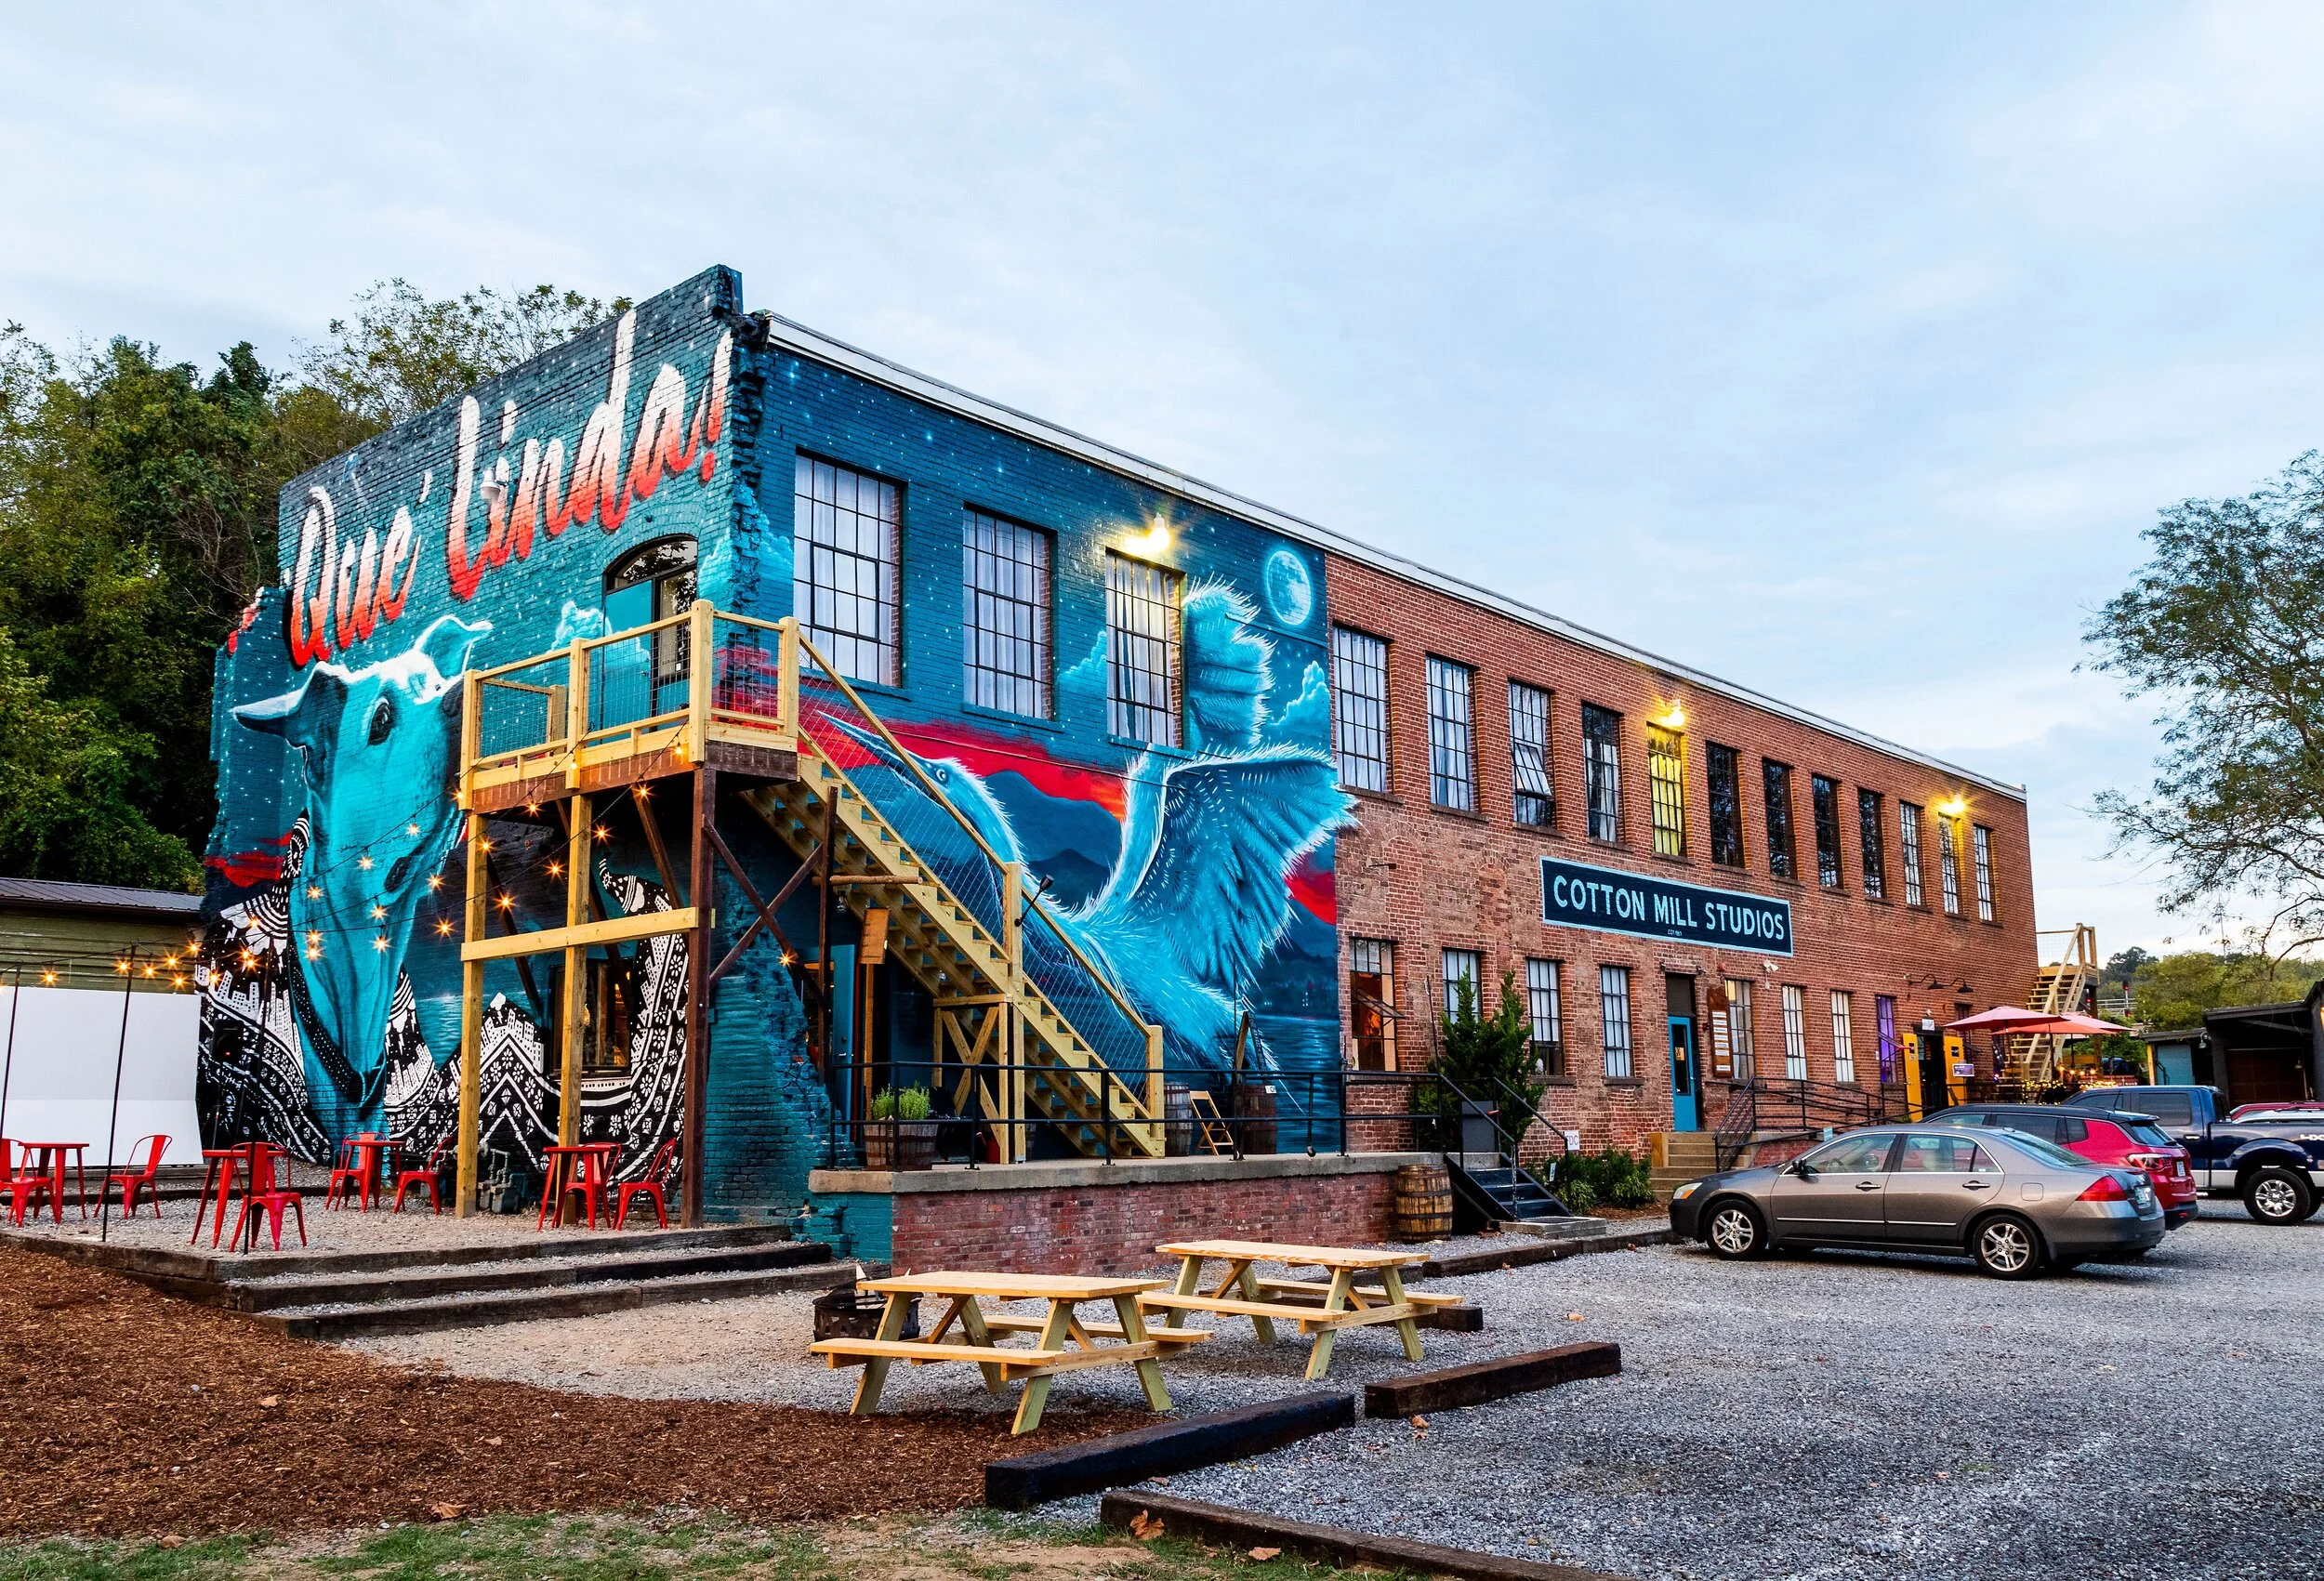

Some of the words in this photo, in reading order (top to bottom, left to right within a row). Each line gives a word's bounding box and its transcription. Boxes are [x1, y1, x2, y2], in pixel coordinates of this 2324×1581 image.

[1553, 875, 1645, 921] COTTON
[1653, 893, 1697, 927] MILL
[1705, 902, 1785, 941] STUDIOS
